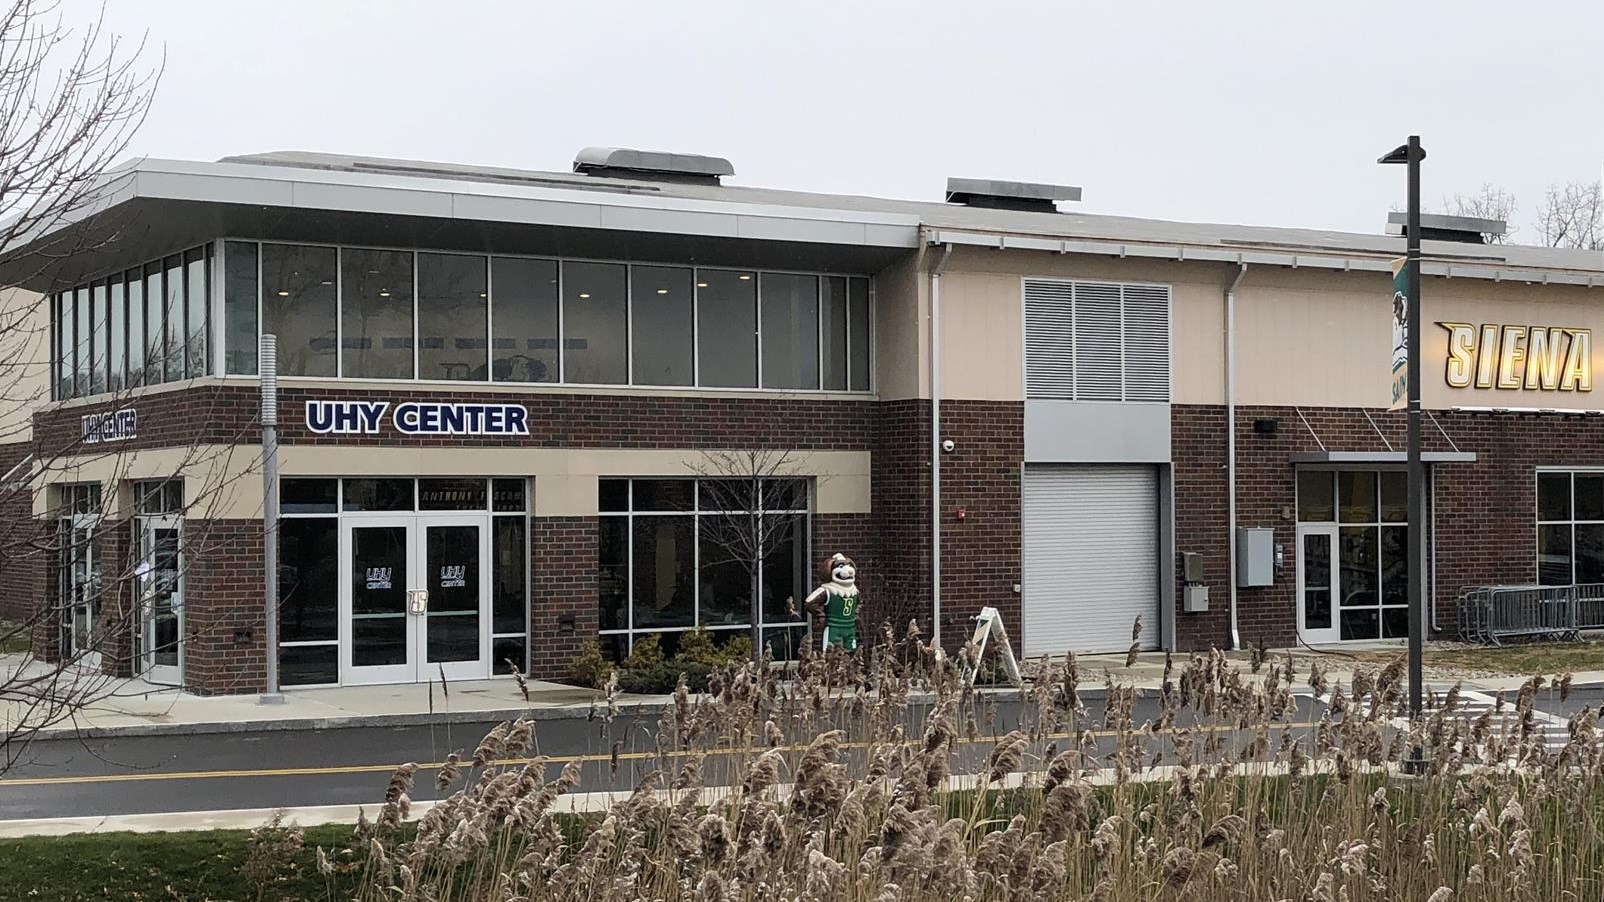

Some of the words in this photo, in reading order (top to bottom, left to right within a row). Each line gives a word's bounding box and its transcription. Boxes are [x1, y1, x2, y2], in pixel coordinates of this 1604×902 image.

[1434, 321, 1593, 393] SIENA
[305, 400, 389, 434] UHY
[393, 402, 530, 436] CENTER
[366, 567, 392, 581] UHY
[441, 565, 466, 580] UHY
[843, 598, 854, 616] S
